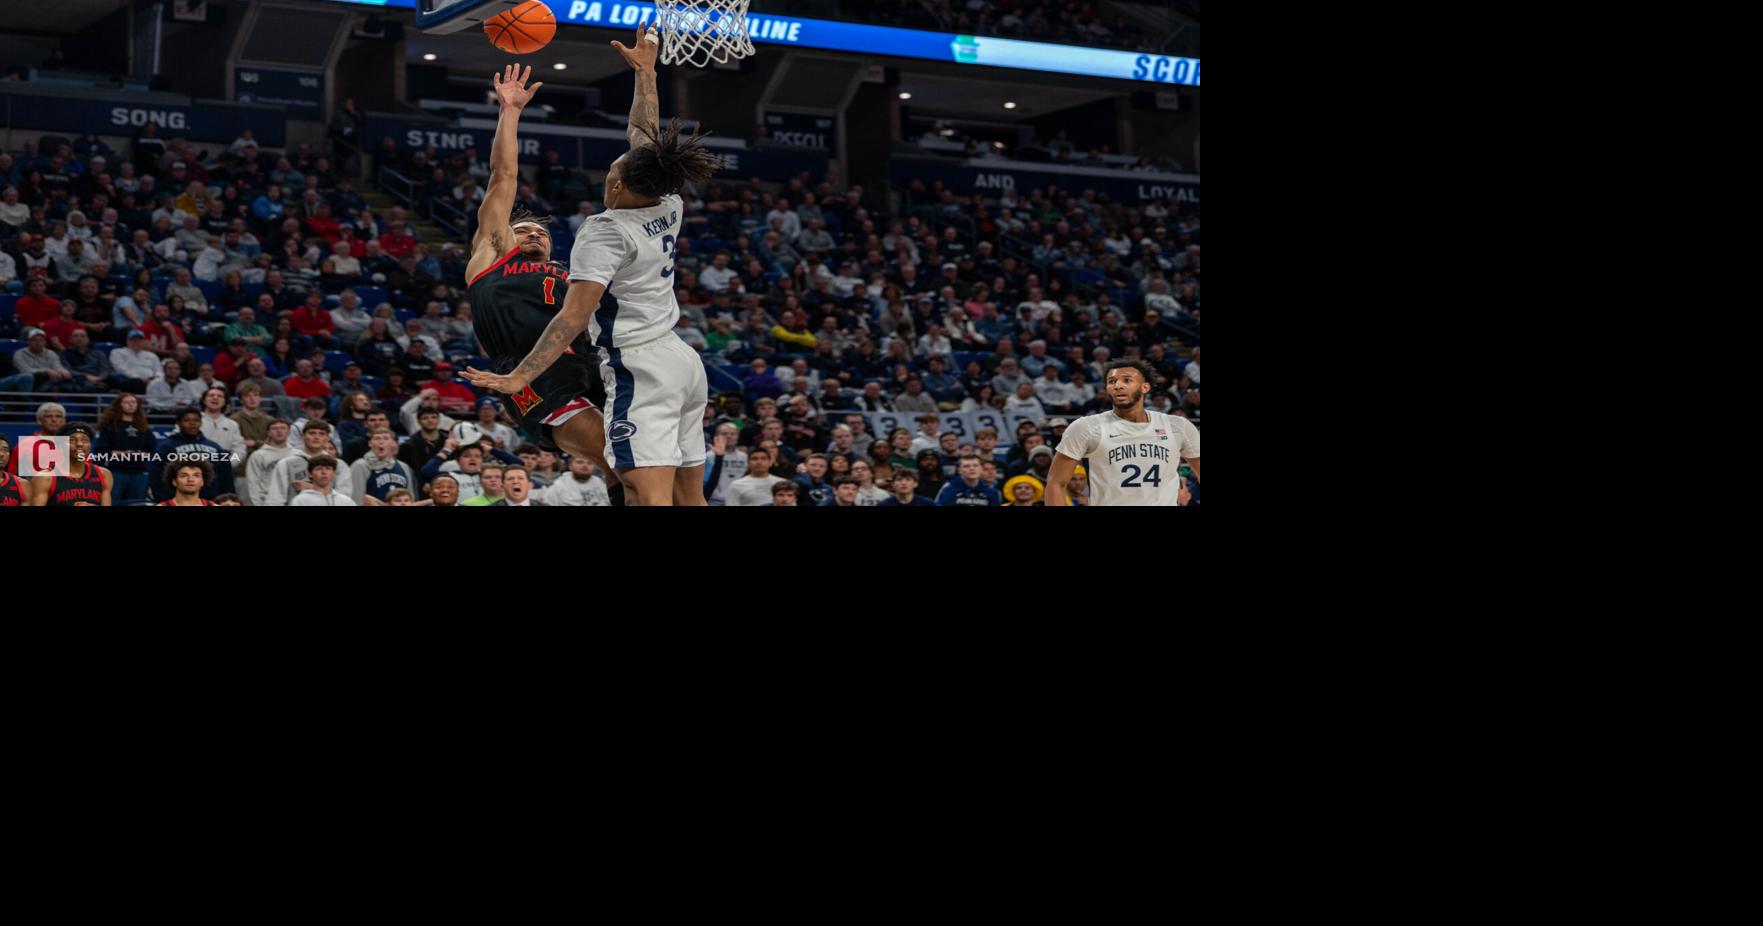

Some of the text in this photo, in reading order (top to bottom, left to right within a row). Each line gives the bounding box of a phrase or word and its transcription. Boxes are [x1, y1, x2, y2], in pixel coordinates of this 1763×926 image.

[568, 1, 601, 22] PA
[407, 129, 475, 150] SING
[974, 173, 1016, 191] AND
[642, 219, 669, 238] KERN
[660, 234, 676, 278] 3
[542, 277, 555, 305] 1
[510, 384, 544, 417] M
[880, 416, 898, 434] 3
[947, 416, 965, 437] 3
[1108, 443, 1170, 464] PENN STATE
[1120, 463, 1162, 488] 24
